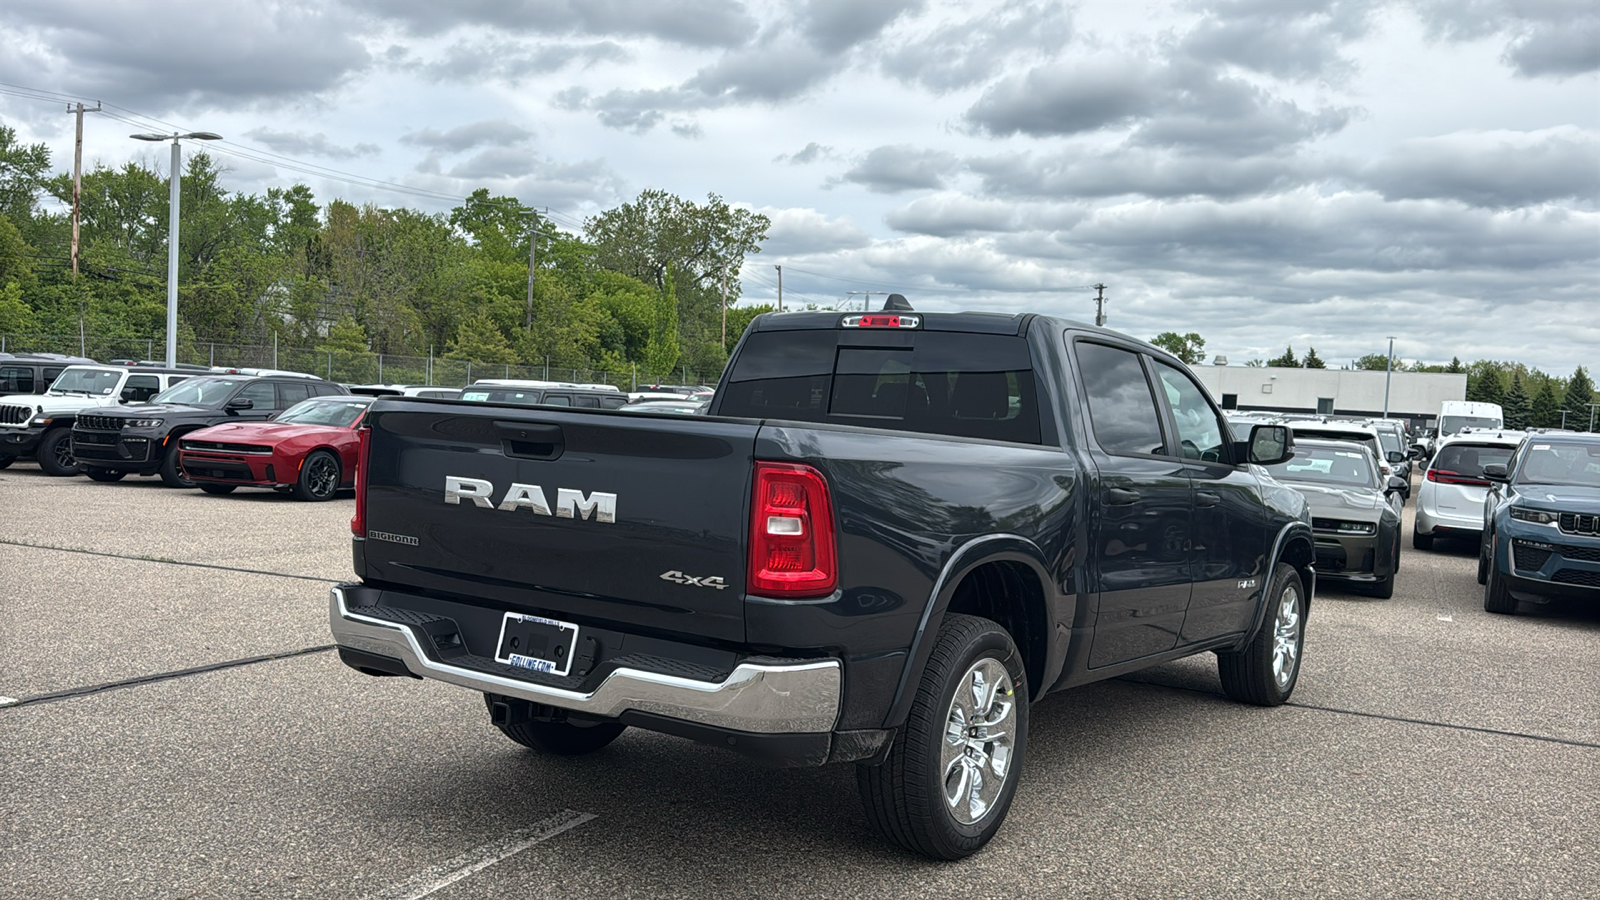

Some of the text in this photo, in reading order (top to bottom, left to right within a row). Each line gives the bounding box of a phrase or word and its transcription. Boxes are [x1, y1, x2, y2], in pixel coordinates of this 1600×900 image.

[445, 475, 618, 524] RAM
[368, 529, 419, 546] BIGHORN
[659, 570, 729, 590] 4x4
